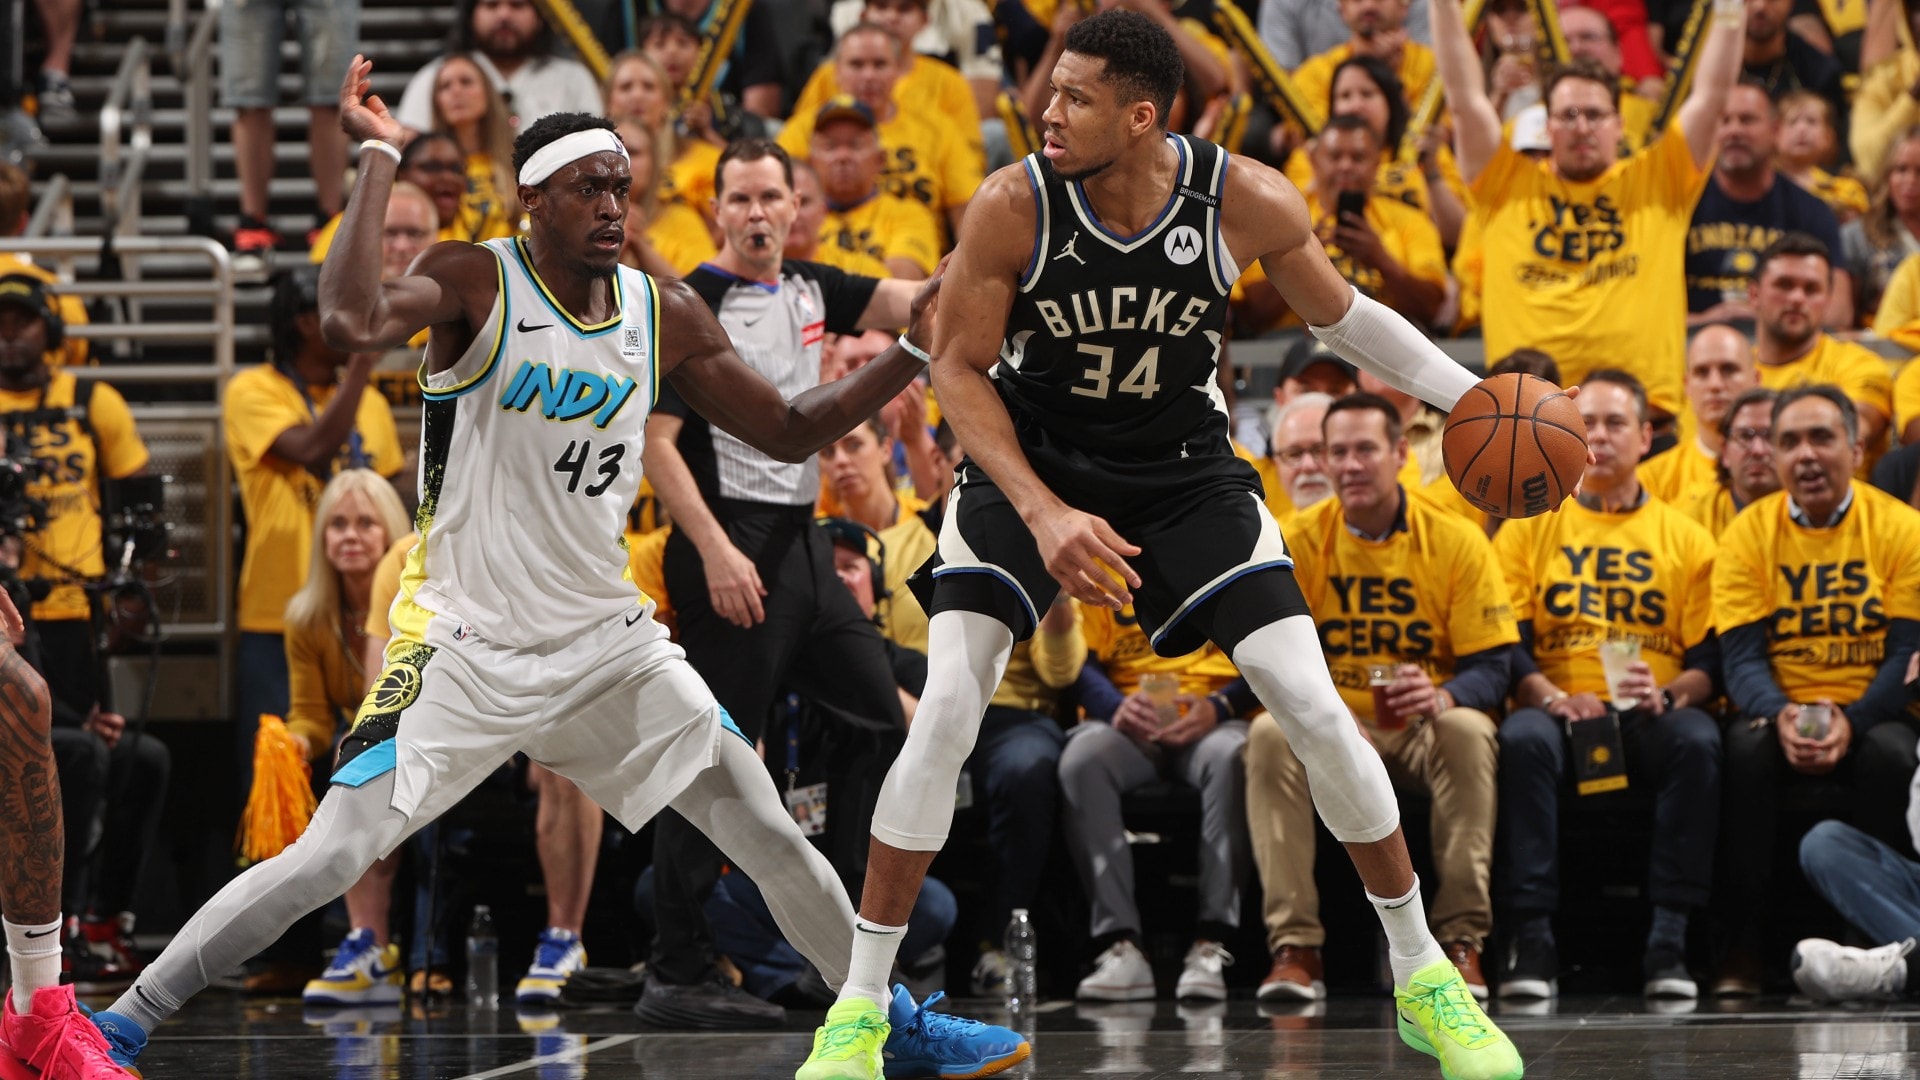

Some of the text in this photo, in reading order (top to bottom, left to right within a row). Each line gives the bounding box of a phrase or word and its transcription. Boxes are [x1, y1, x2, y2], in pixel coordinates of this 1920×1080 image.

[1179, 187, 1217, 206] BRIDGEMAN
[1035, 286, 1211, 338] BUCKS
[1070, 342, 1161, 400] 34
[499, 360, 637, 430] INDY
[554, 438, 626, 498] 43
[1561, 546, 1654, 583] YES
[1780, 560, 1869, 602] YES
[1330, 576, 1416, 616] YES
